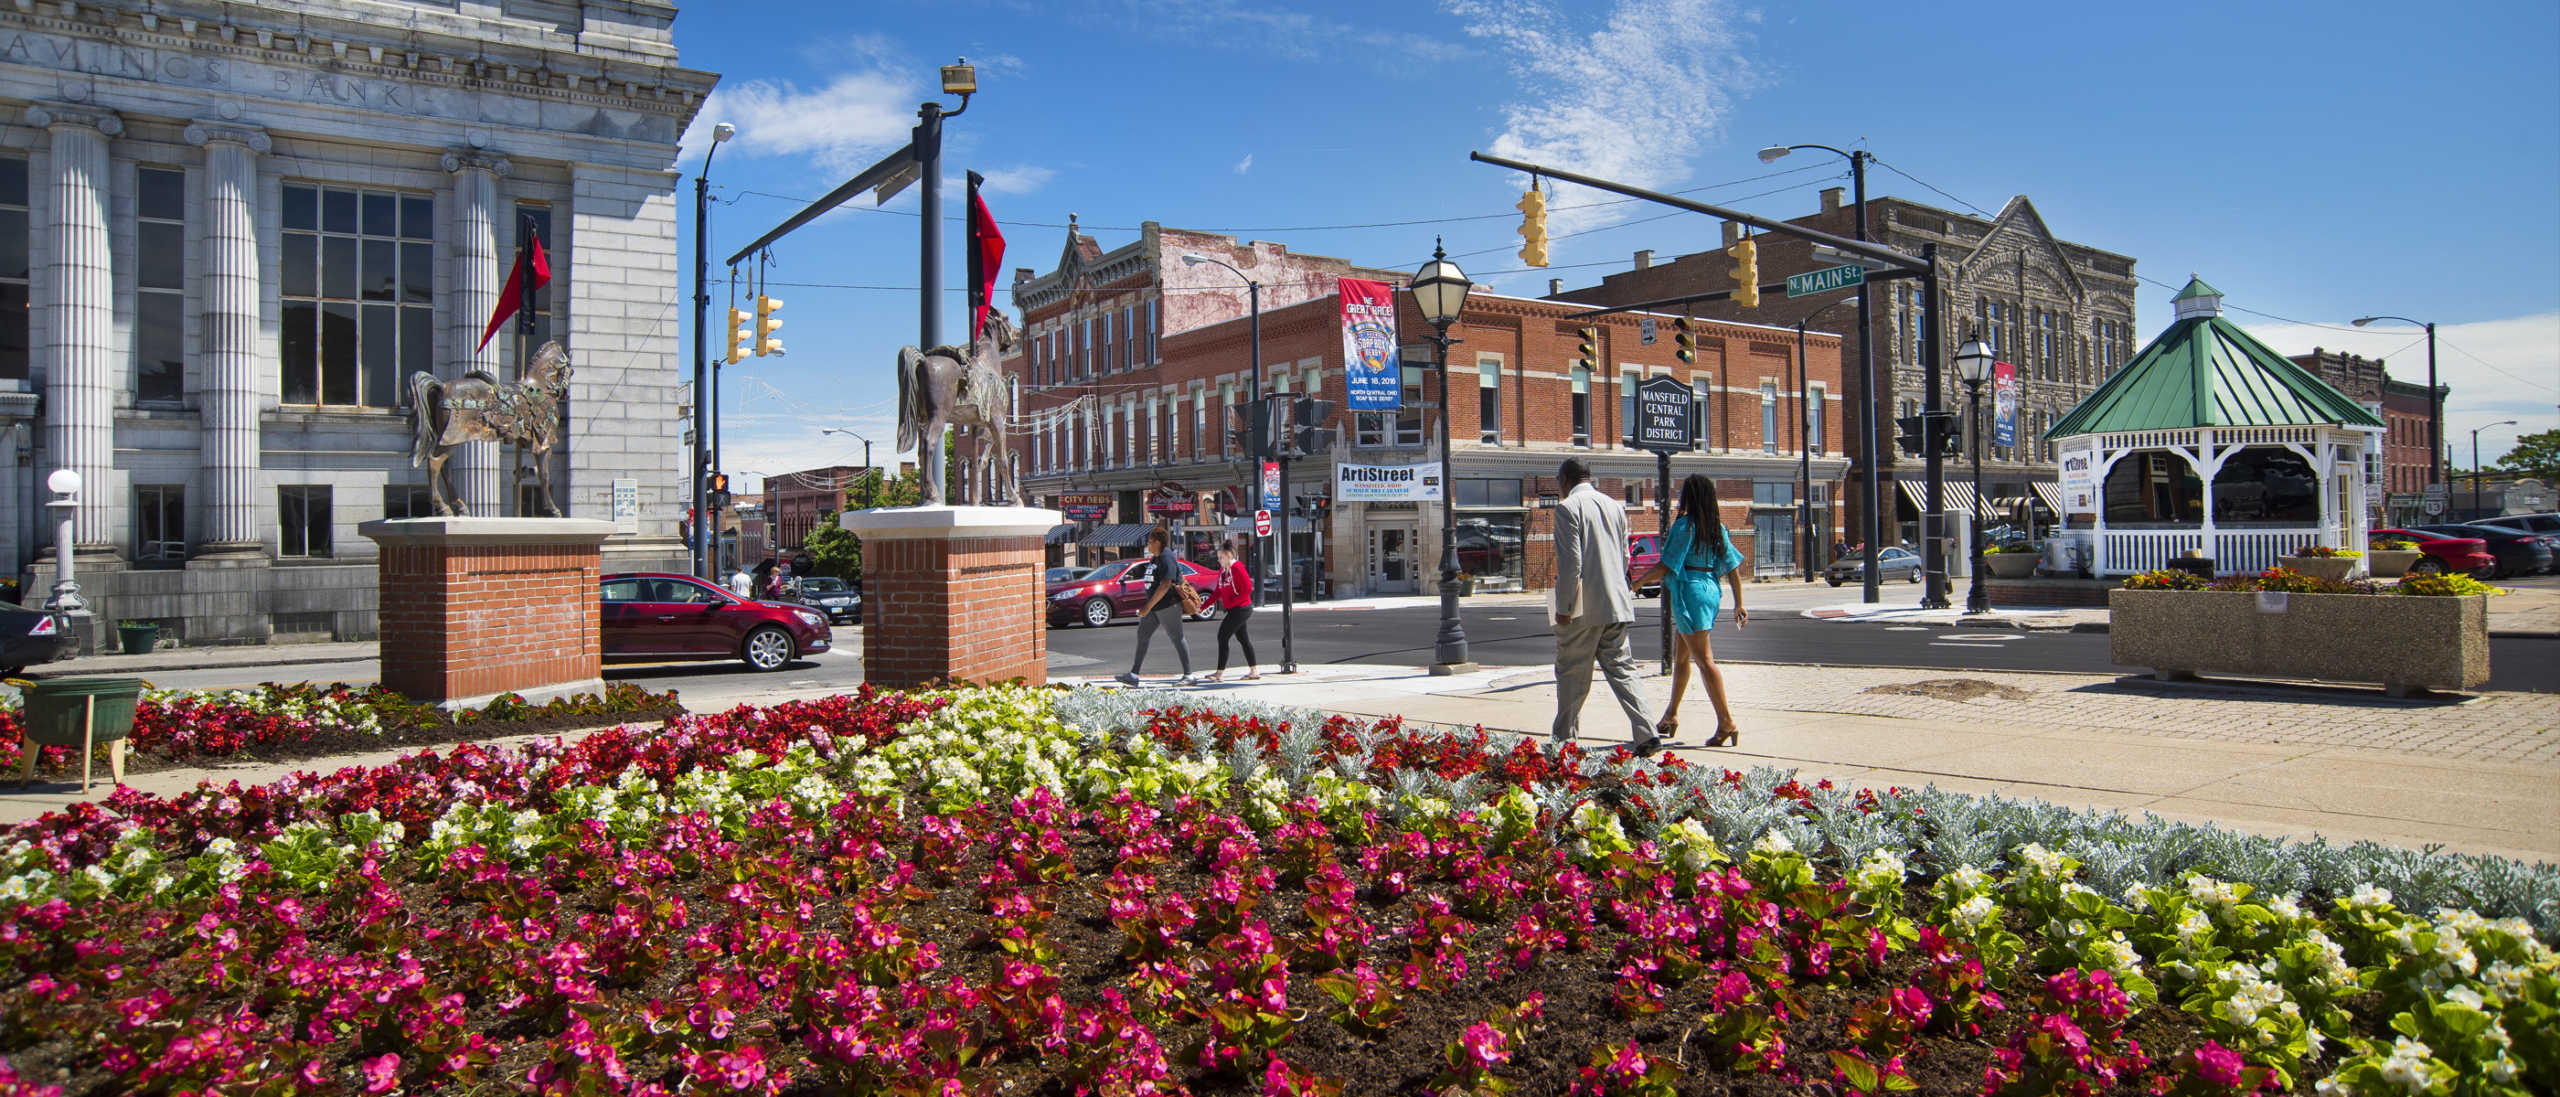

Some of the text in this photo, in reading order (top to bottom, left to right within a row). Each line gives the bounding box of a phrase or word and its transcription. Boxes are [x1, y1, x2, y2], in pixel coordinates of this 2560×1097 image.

[273, 70, 403, 108] BANK
[1790, 267, 1860, 293] N. MAIN St.
[1346, 303, 1393, 317] GREAT RACE
[1351, 377, 1369, 385] JUNE
[1381, 377, 1397, 385] 2016
[1642, 390, 1688, 404] MANSFIELD
[1646, 403, 1684, 416] CENTRAL
[1653, 416, 1676, 427] PARK
[1646, 427, 1683, 440] DISTRICT
[1342, 467, 1415, 482] ArtiStreet
[1064, 495, 1083, 504] CITY
[2427, 502, 2440, 512] 13
